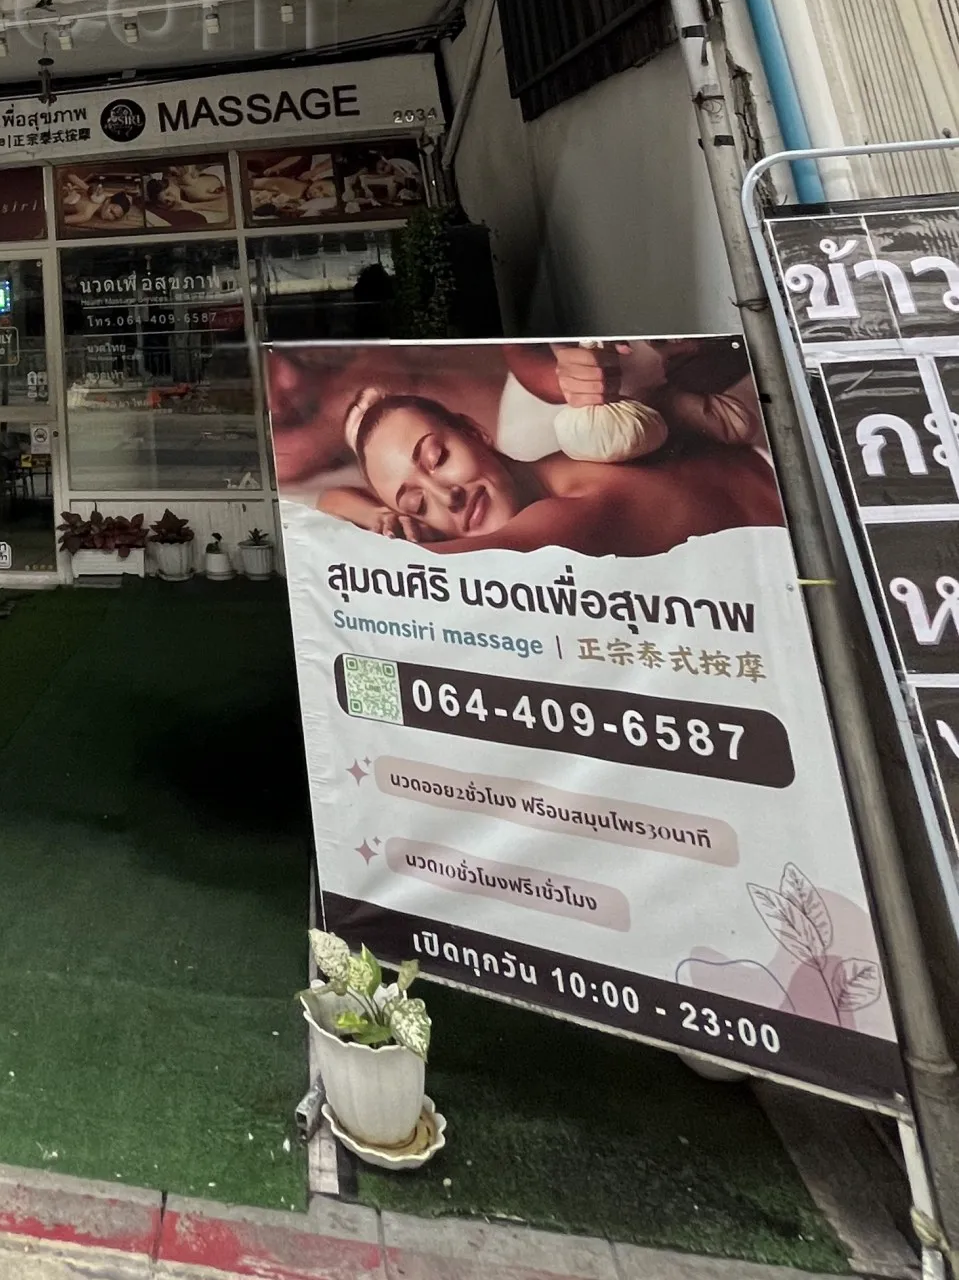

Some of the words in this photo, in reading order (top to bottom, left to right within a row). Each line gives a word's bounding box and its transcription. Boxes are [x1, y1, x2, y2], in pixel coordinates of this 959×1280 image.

[157, 84, 361, 133] MASSAGE
[79, 270, 221, 296] นวดเพื่อสุขภาพ
[327, 562, 451, 603] สุมณศิริ
[460, 565, 756, 635] นวดเพื่อสุขภาพ
[333, 609, 436, 642] Sumonsiri
[442, 626, 544, 659] massage
[576, 636, 768, 684] 正宗泰式按摩
[411, 678, 746, 761] 064-409-6587
[389, 772, 517, 809] นวดออย2ชั่วโมง
[521, 795, 713, 850] ฟรีอบสมุนไพร30นาที
[405, 851, 598, 912] นวด10ชั่วโมงฟรี1ชั่วโมง
[412, 929, 538, 987] เปิดทุกวัน
[550, 967, 641, 1015] 10:00
[678, 1001, 782, 1055] 23:00
